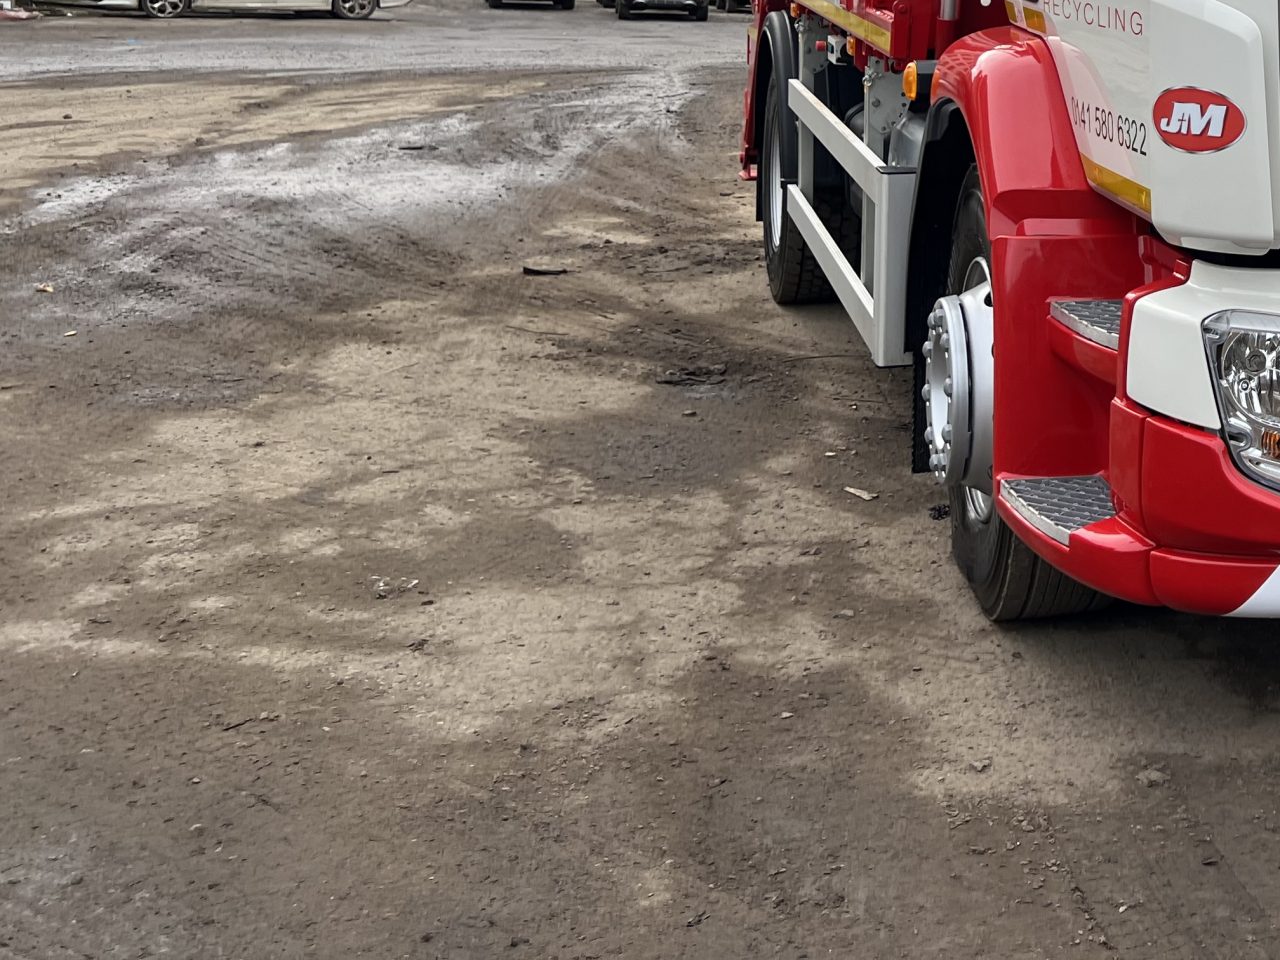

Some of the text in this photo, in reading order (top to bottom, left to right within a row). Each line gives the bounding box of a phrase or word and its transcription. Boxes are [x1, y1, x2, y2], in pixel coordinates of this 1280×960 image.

[1071, 96, 1147, 156] 0141 580 6322
